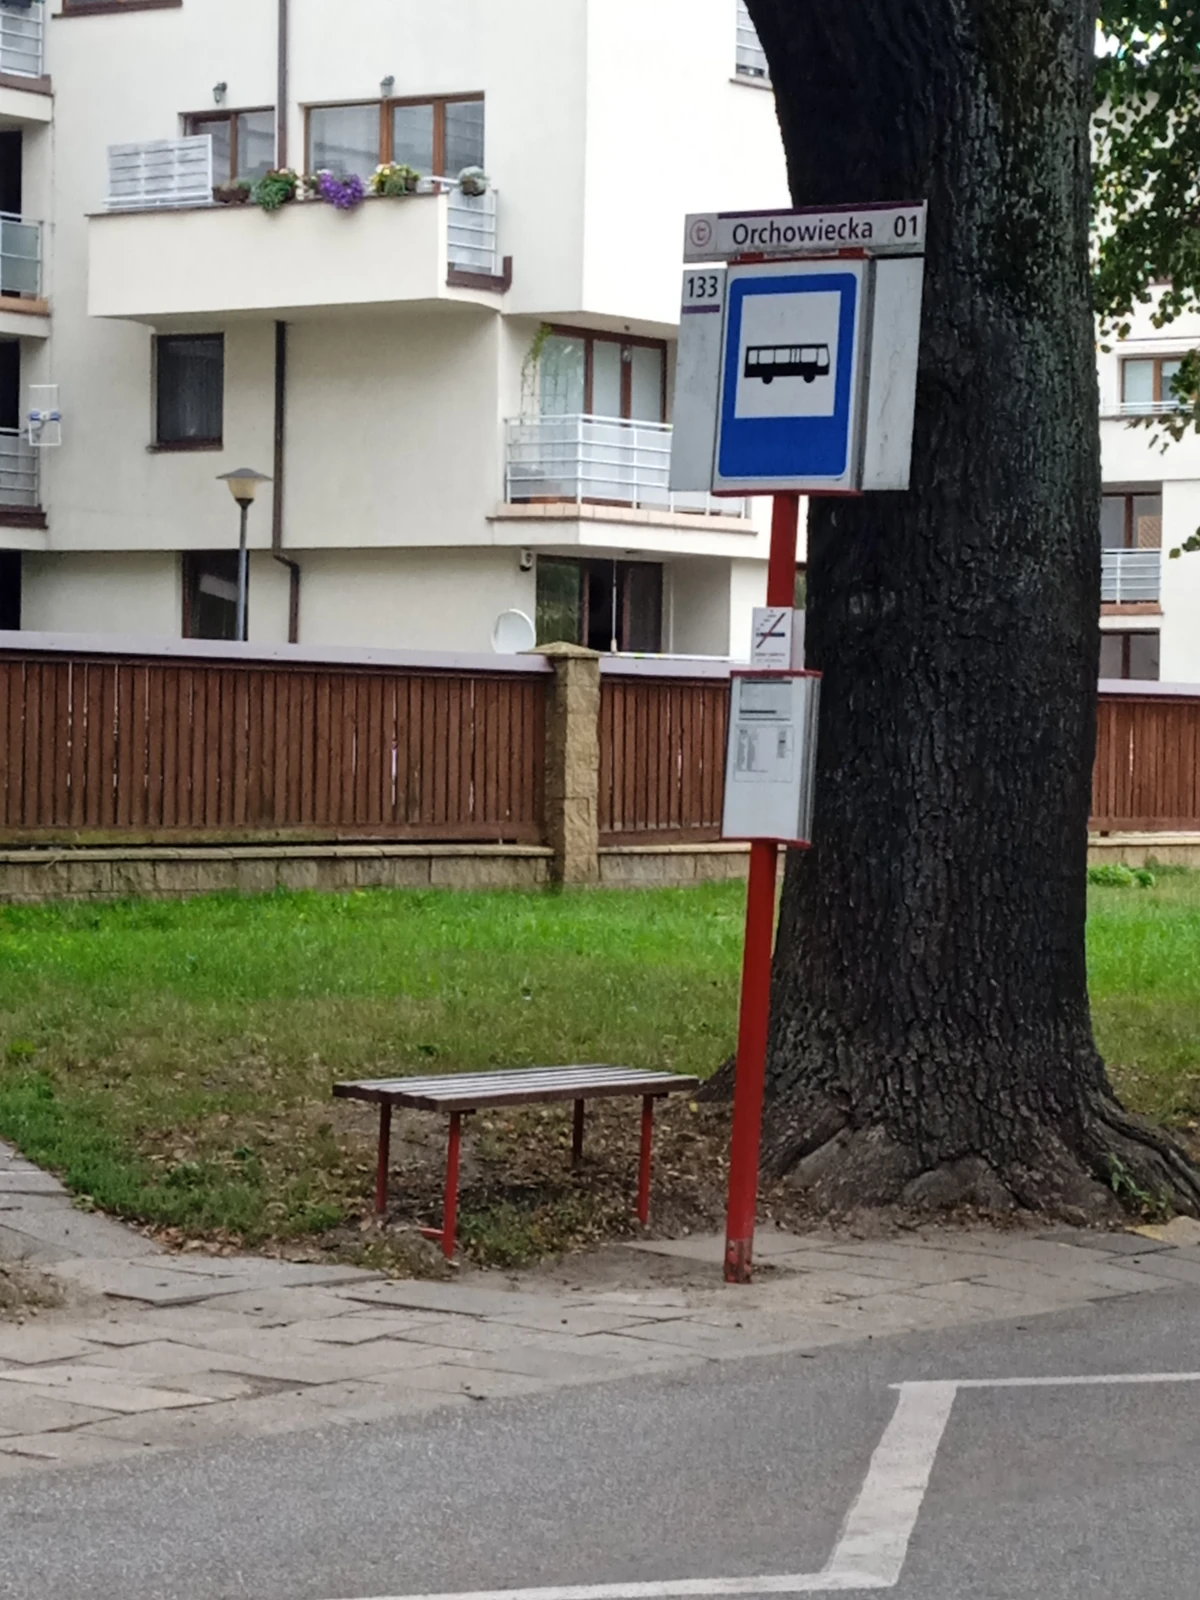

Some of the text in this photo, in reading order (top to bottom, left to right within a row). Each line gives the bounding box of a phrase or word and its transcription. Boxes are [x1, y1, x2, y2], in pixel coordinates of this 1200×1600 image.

[732, 215, 918, 245] Orchowiecka 01
[687, 276, 718, 298] 133
